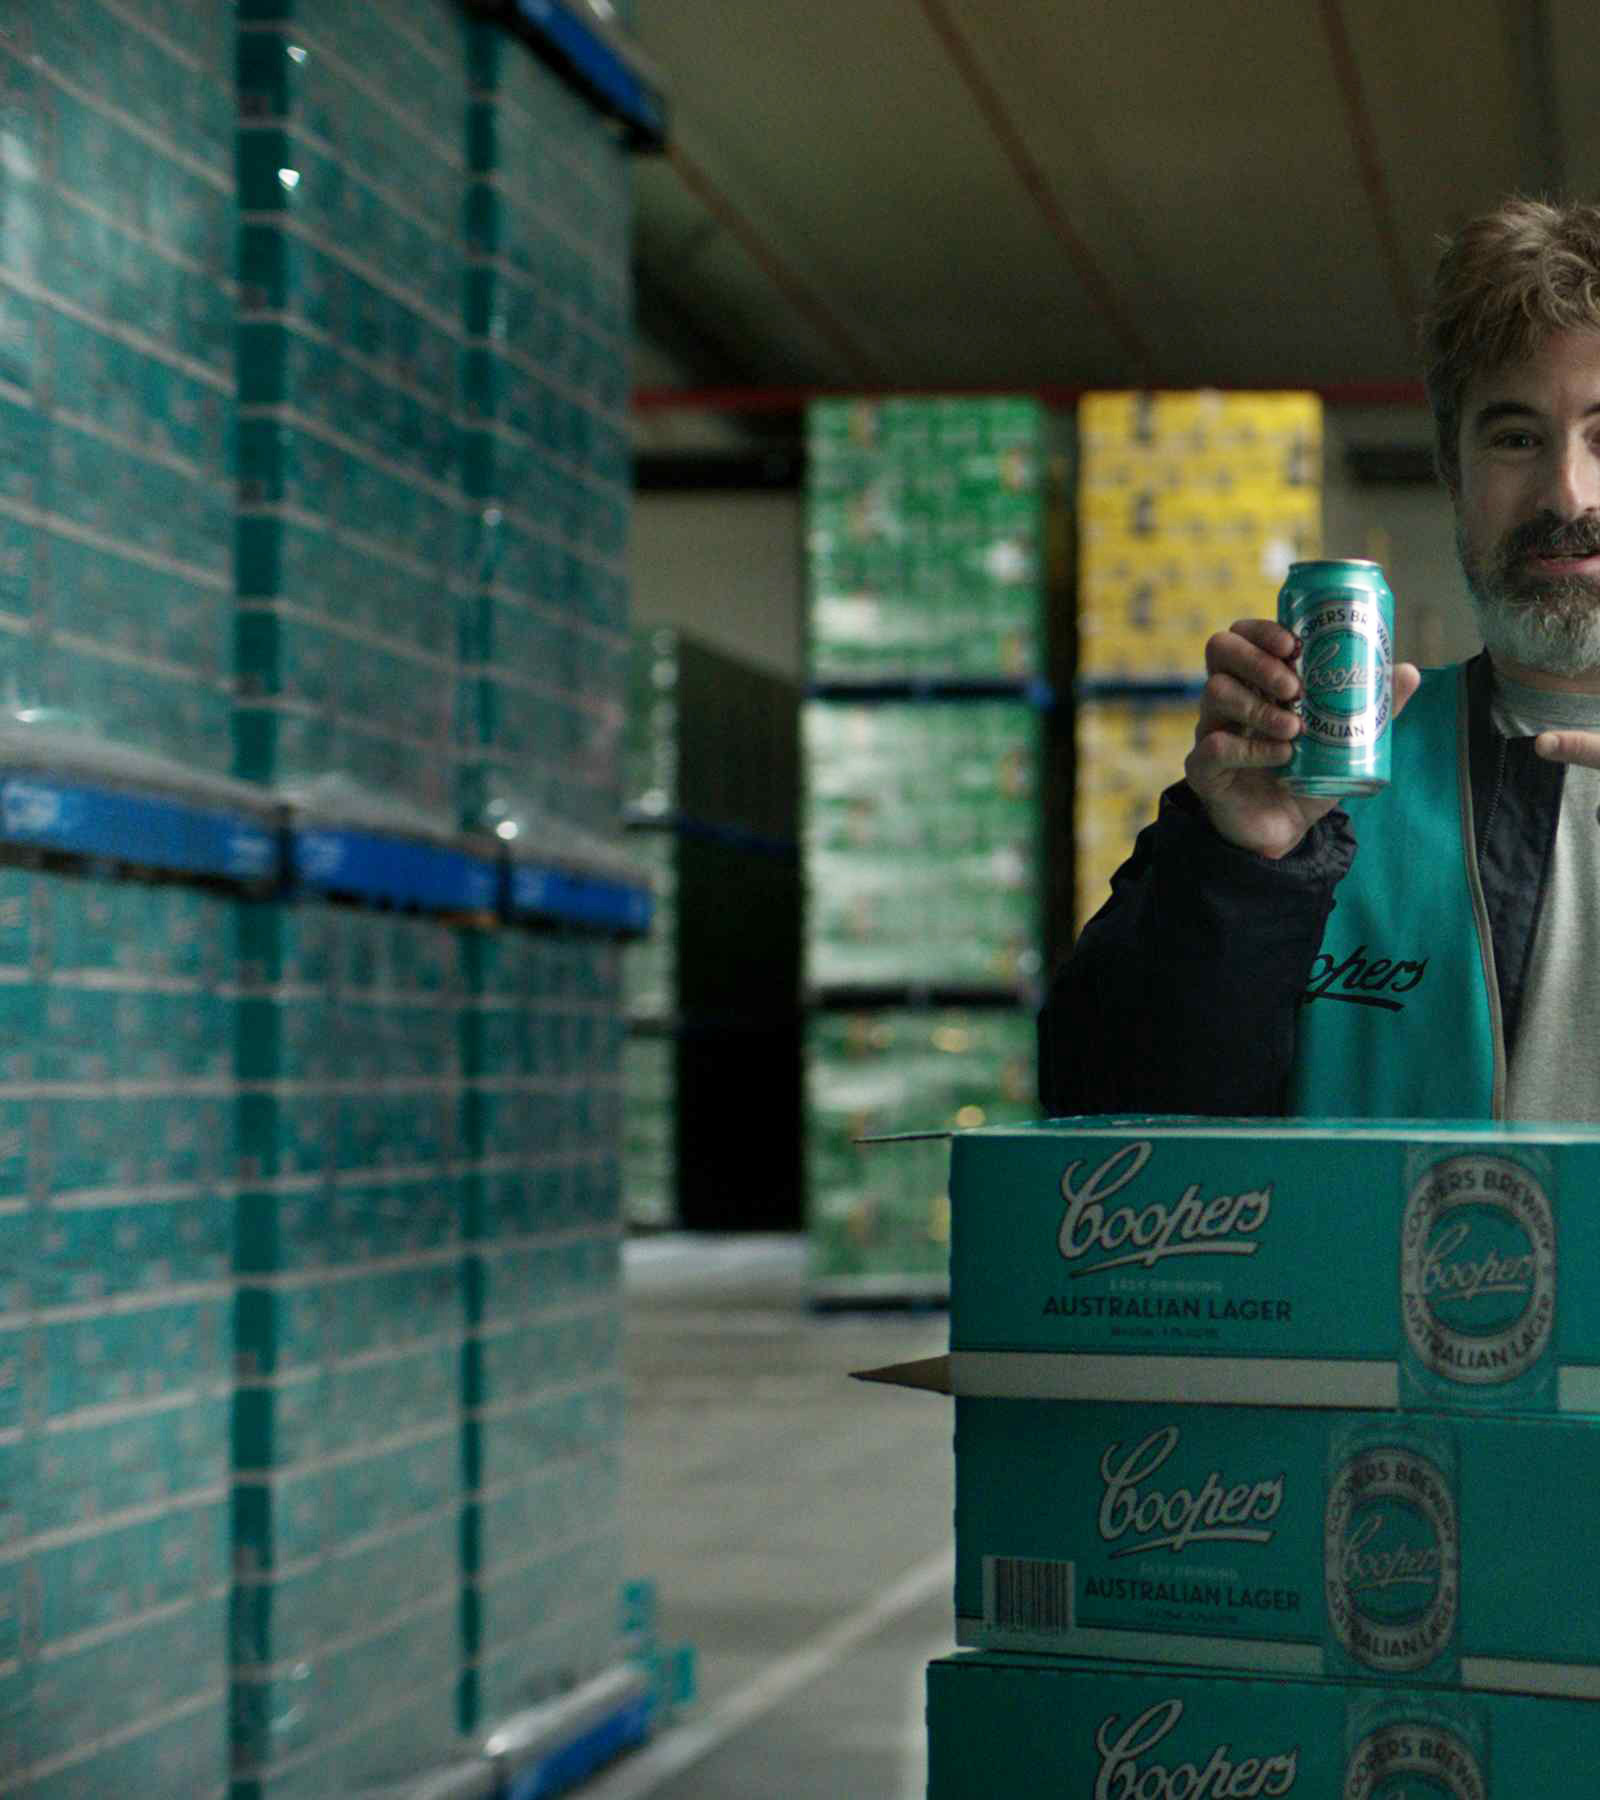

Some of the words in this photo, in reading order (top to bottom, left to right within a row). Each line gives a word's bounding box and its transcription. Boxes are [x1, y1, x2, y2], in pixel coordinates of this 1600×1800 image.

[1300, 608, 1346, 641] OPERS
[1350, 609, 1392, 664] BRWERY
[1305, 944, 1430, 1012] opers
[1058, 1140, 1276, 1279] Coopers
[1423, 1223, 1536, 1300] Coopers
[1042, 1295, 1199, 1319] AUSTRALIAN
[1207, 1298, 1293, 1322] LAGER
[1099, 1424, 1286, 1560] Coopers
[1084, 1577, 1221, 1608] AUSTRALIAN
[1227, 1585, 1300, 1612] LAGER
[1095, 1698, 1299, 1800] Coopers
